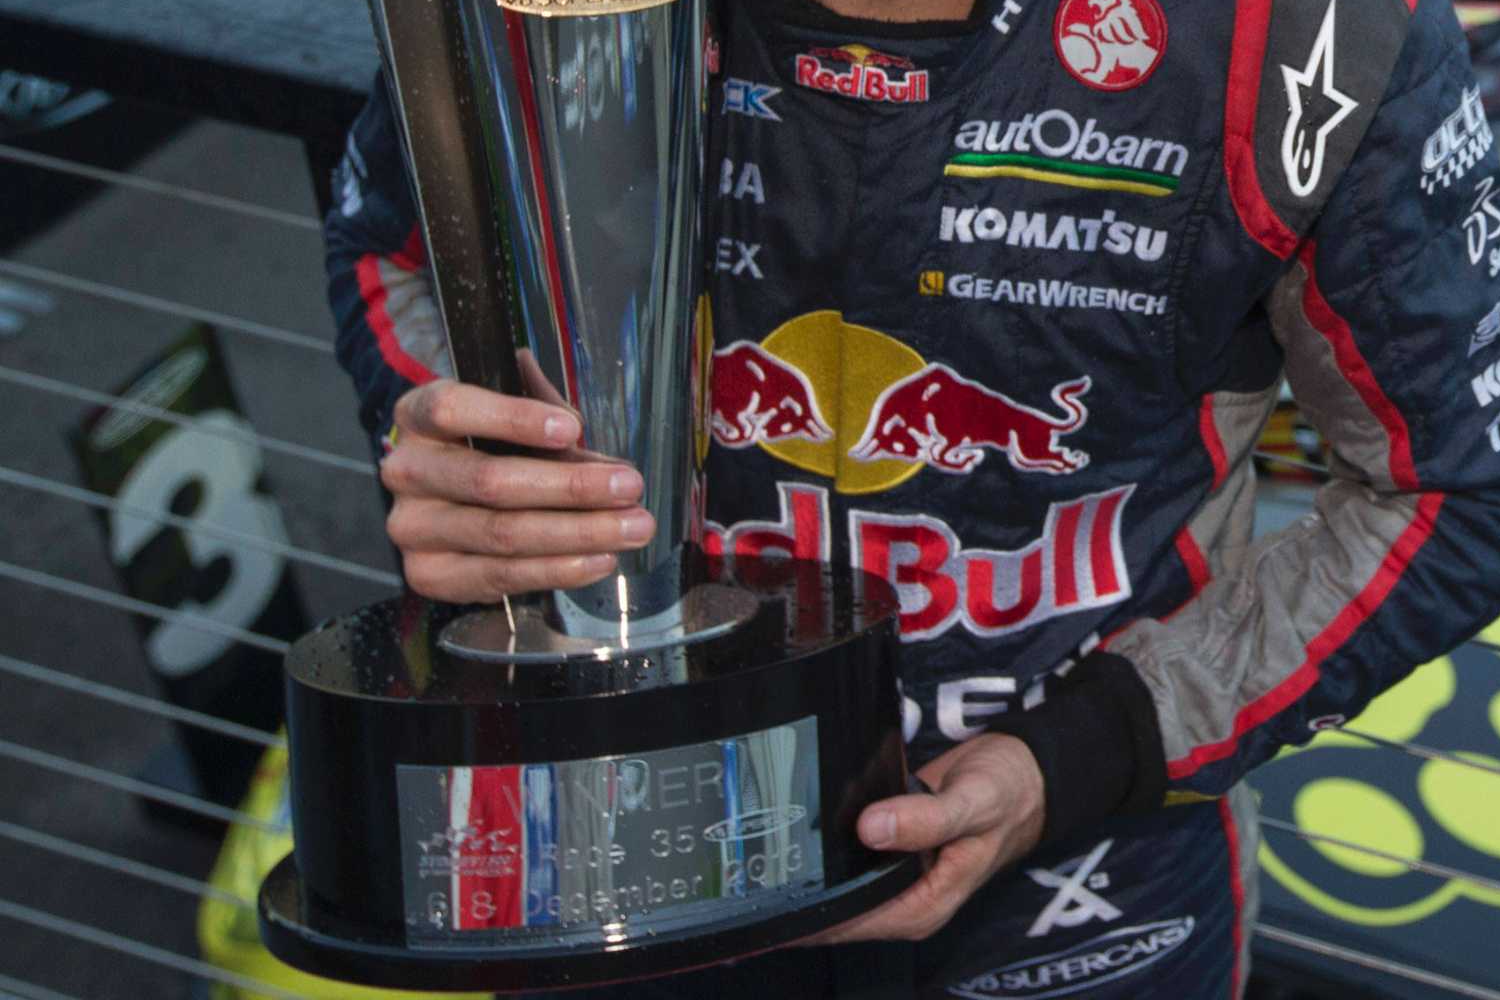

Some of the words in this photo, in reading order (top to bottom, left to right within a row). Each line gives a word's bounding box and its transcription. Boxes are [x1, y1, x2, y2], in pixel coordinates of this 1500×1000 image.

[796, 55, 863, 97] Red
[862, 66, 929, 103] Bull
[938, 205, 1168, 262] KOMATSU
[848, 483, 1137, 643] Bull
[650, 825, 697, 859] 35
[1000, 925, 1188, 992] SUPERCARS
